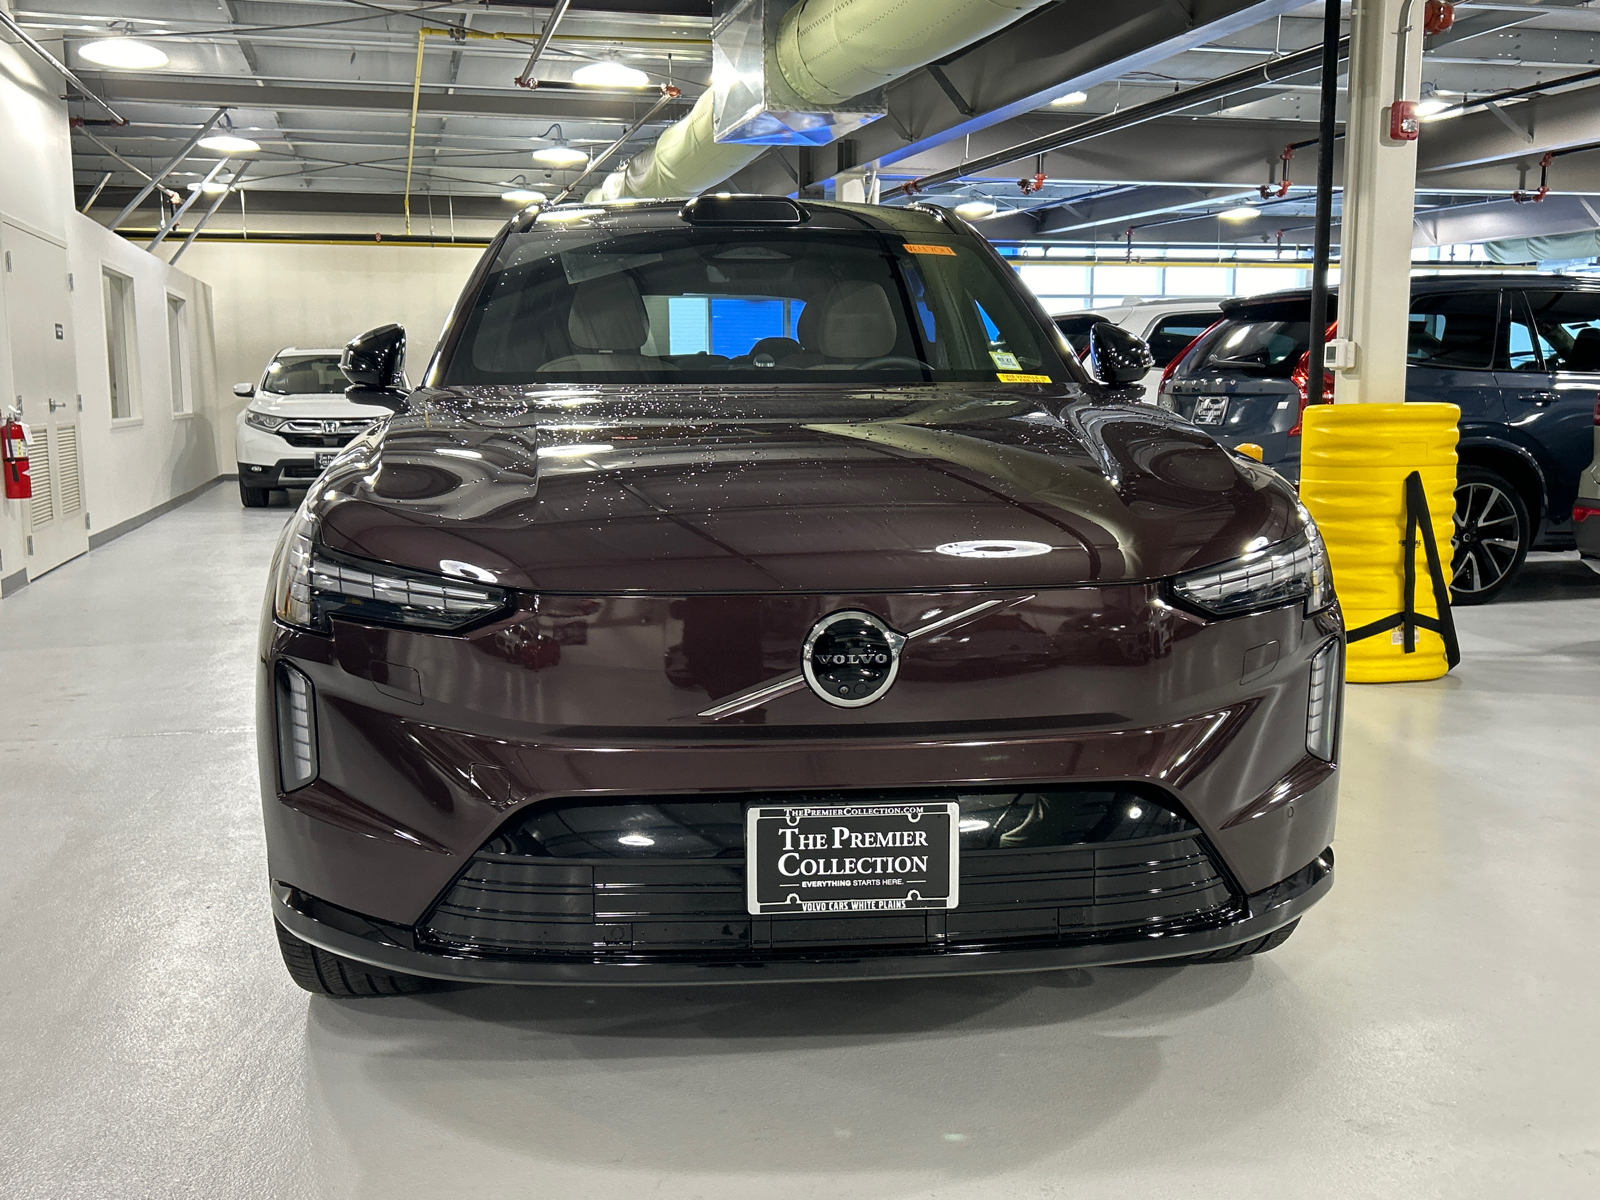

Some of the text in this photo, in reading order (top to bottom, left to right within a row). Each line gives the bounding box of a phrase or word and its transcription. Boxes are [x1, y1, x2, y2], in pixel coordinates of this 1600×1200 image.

[815, 653, 888, 664] VOLVO
[802, 880, 851, 888] EVERYTHING
[852, 879, 881, 887] STARTS
[802, 900, 907, 911] VOLVO CARS WHITE PLAINS
